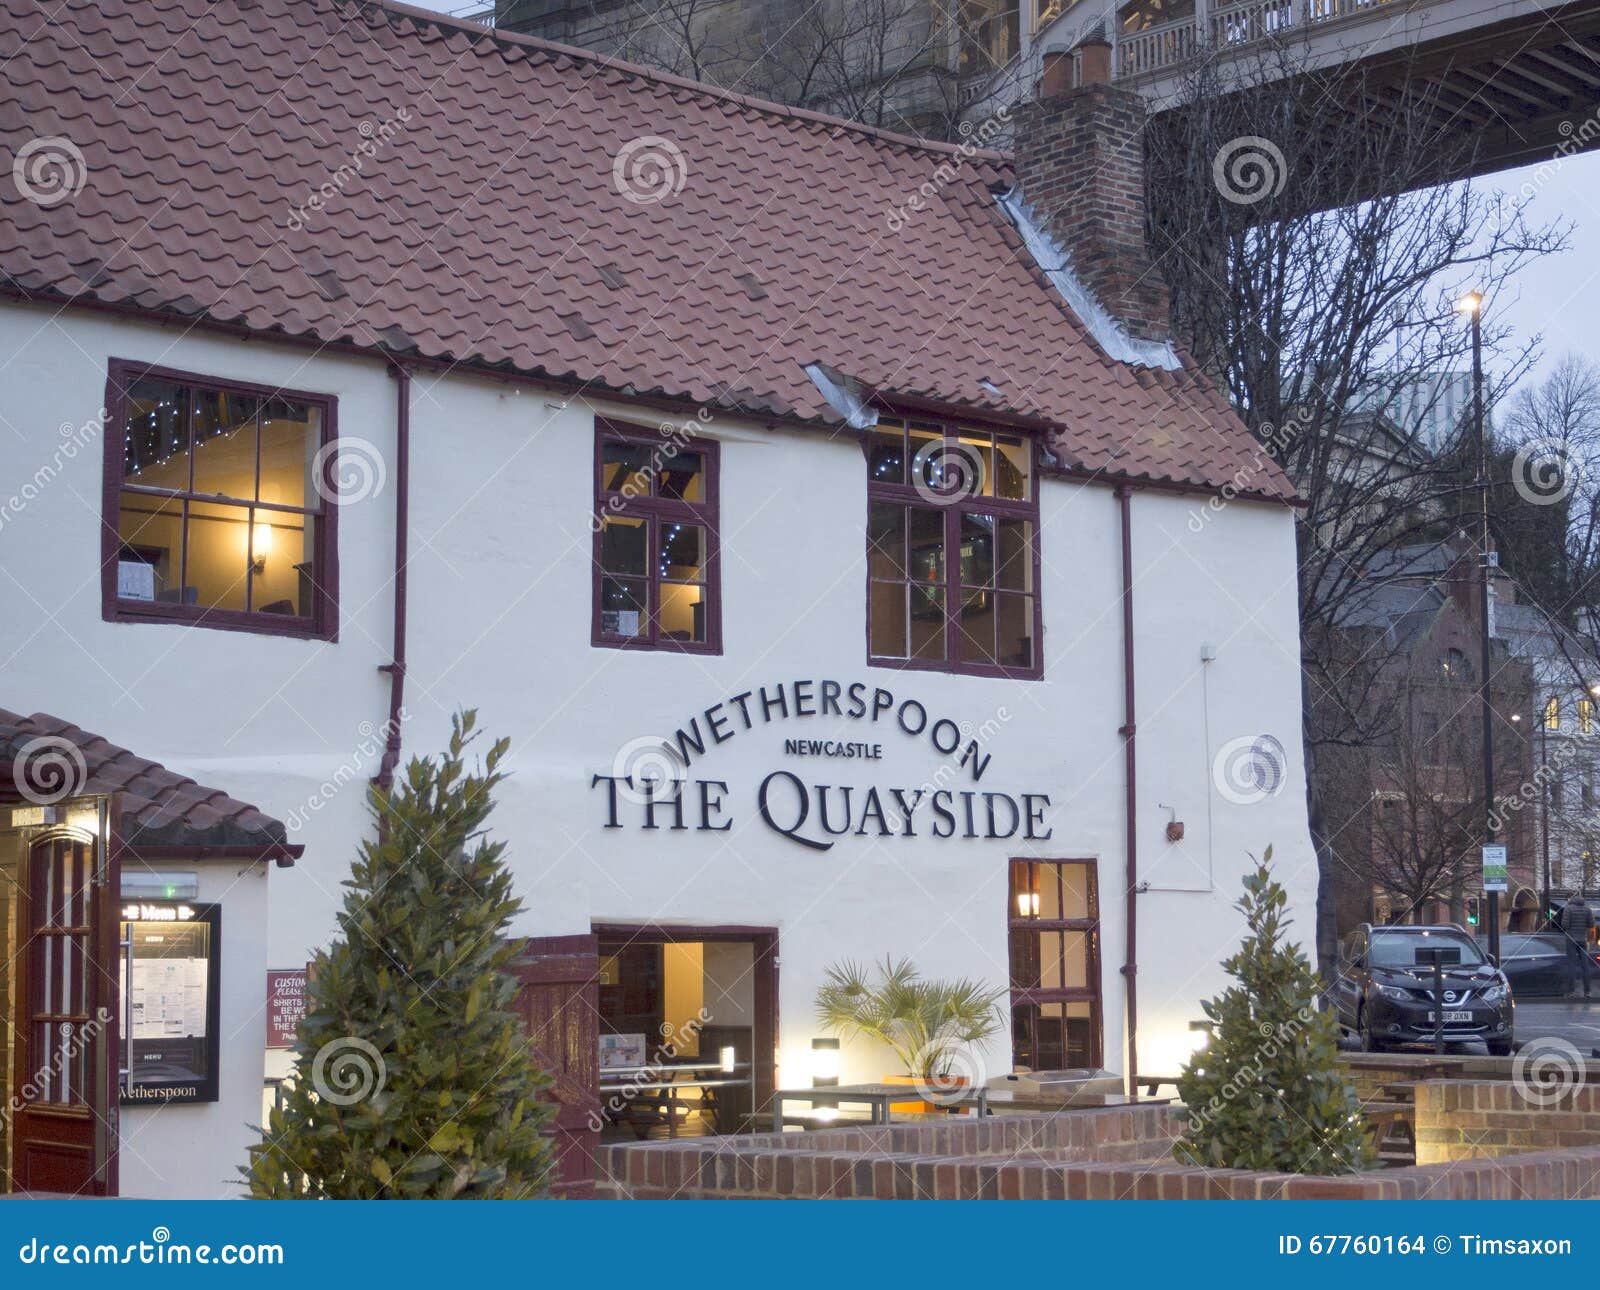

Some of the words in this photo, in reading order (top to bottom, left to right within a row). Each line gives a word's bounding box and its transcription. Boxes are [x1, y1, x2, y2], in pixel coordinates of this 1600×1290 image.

[662, 680, 991, 782] WETHERSPOON
[785, 738, 882, 759] NEWCASTLE
[592, 774, 733, 831] THE
[758, 770, 1053, 851] QUAYSIDE
[274, 977, 306, 988] CUSTOM
[276, 987, 305, 996] PLEAS
[273, 998, 303, 1007] SHIRTS
